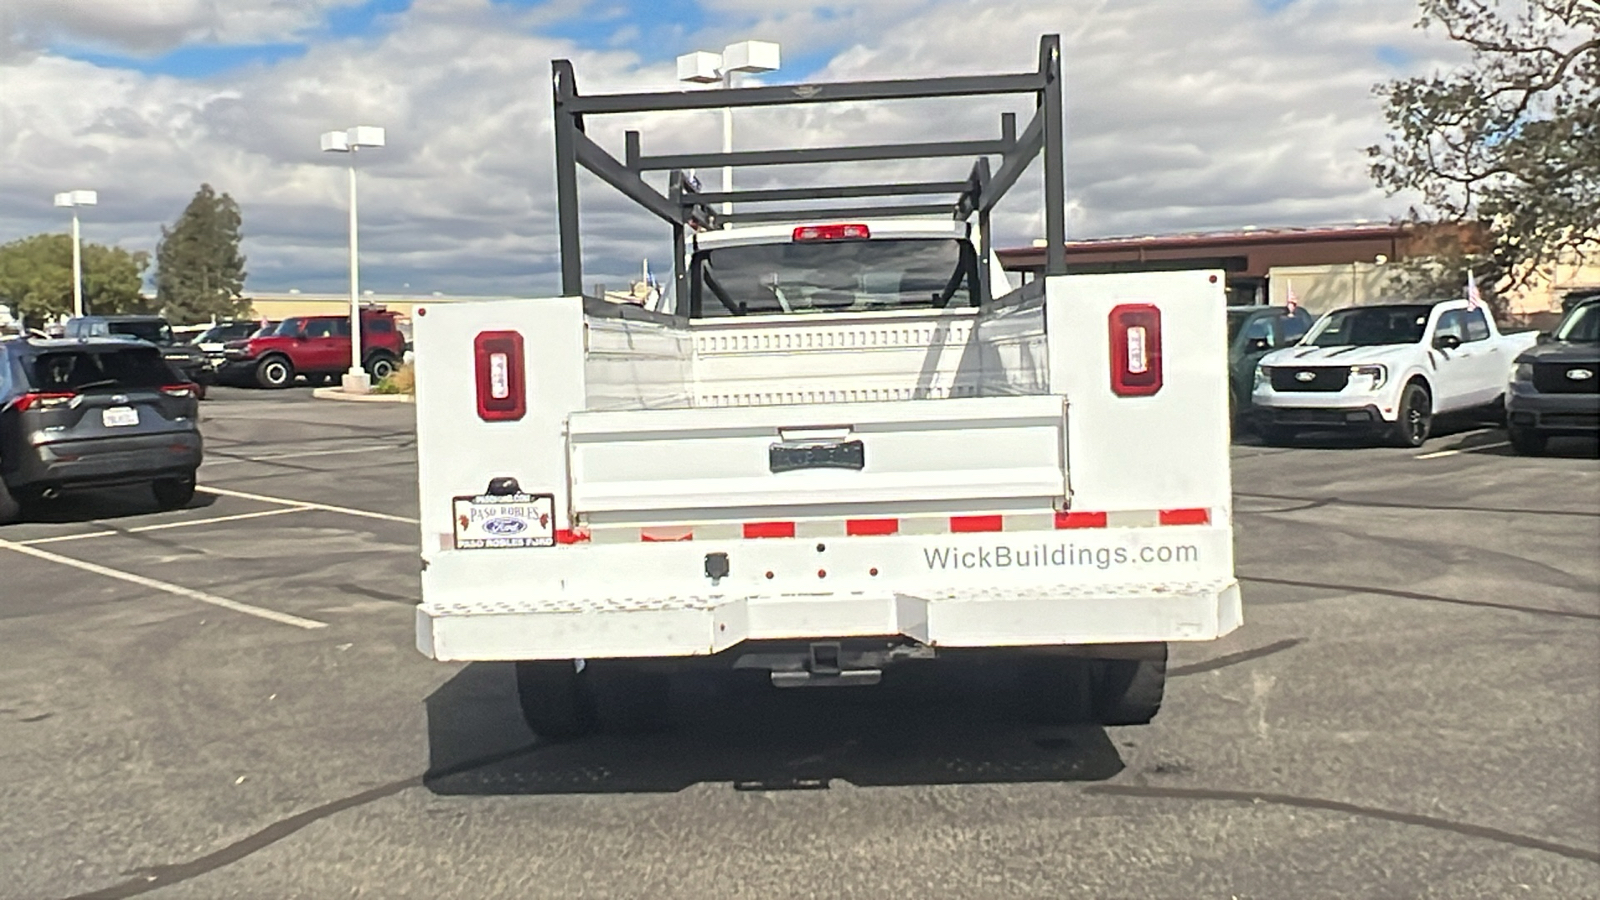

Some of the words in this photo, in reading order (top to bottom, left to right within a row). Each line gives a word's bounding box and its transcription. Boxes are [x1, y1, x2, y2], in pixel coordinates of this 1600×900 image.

[470, 507, 497, 522] PASO
[501, 507, 540, 520] ROBLES
[492, 520, 519, 533] Ford
[458, 540, 484, 548] PASO
[486, 539, 524, 547] ROBLES
[924, 543, 1198, 570] WickBuildings.com
